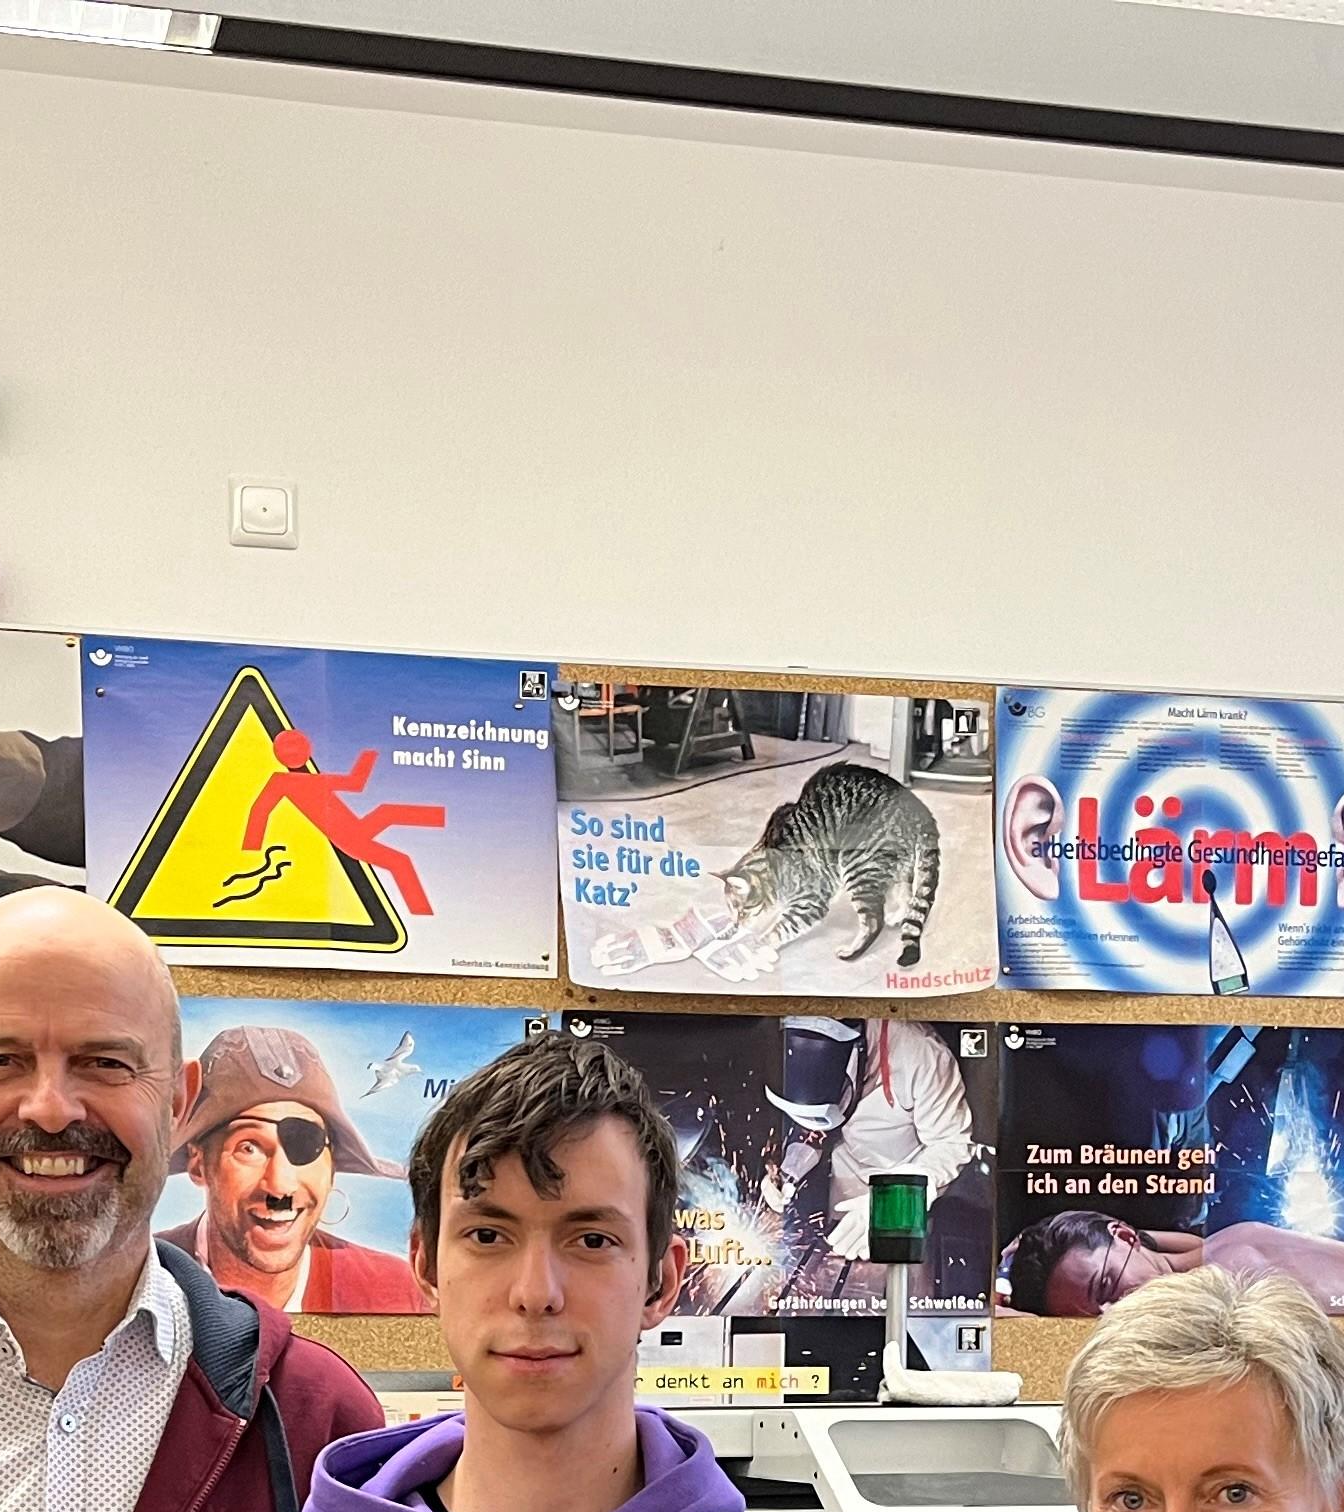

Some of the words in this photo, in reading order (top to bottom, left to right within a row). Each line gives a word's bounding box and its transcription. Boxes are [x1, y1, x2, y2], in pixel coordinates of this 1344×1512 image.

[1168, 707, 1195, 718] Macht
[1197, 708, 1218, 719] Lärm
[1219, 709, 1248, 721] krank?
[392, 715, 549, 750] Kennzeichnung
[393, 746, 455, 768] macht
[462, 749, 505, 771] Sinn
[571, 808, 604, 837] So
[611, 813, 665, 843] sind
[572, 843, 610, 871] sie
[616, 845, 654, 875] für
[659, 850, 701, 878] die
[1031, 835, 1184, 869] arbeitsbedingte
[1078, 795, 1318, 907] Lärm
[886, 967, 993, 989] Handschutz
[1026, 1144, 1073, 1164] Zum
[1080, 1144, 1171, 1165] Bräunen
[1027, 1172, 1058, 1194] ich
[1065, 1177, 1091, 1194] an
[1098, 1172, 1138, 1194] den
[1146, 1172, 1215, 1194] Strand
[674, 1208, 726, 1231] was
[768, 1296, 867, 1313] Gefährdungen
[909, 1296, 984, 1310] Schweißen
[656, 1368, 711, 1389] denkt
[722, 1376, 744, 1389] an
[757, 1372, 799, 1389] mich
[811, 1374, 820, 1389] ?
